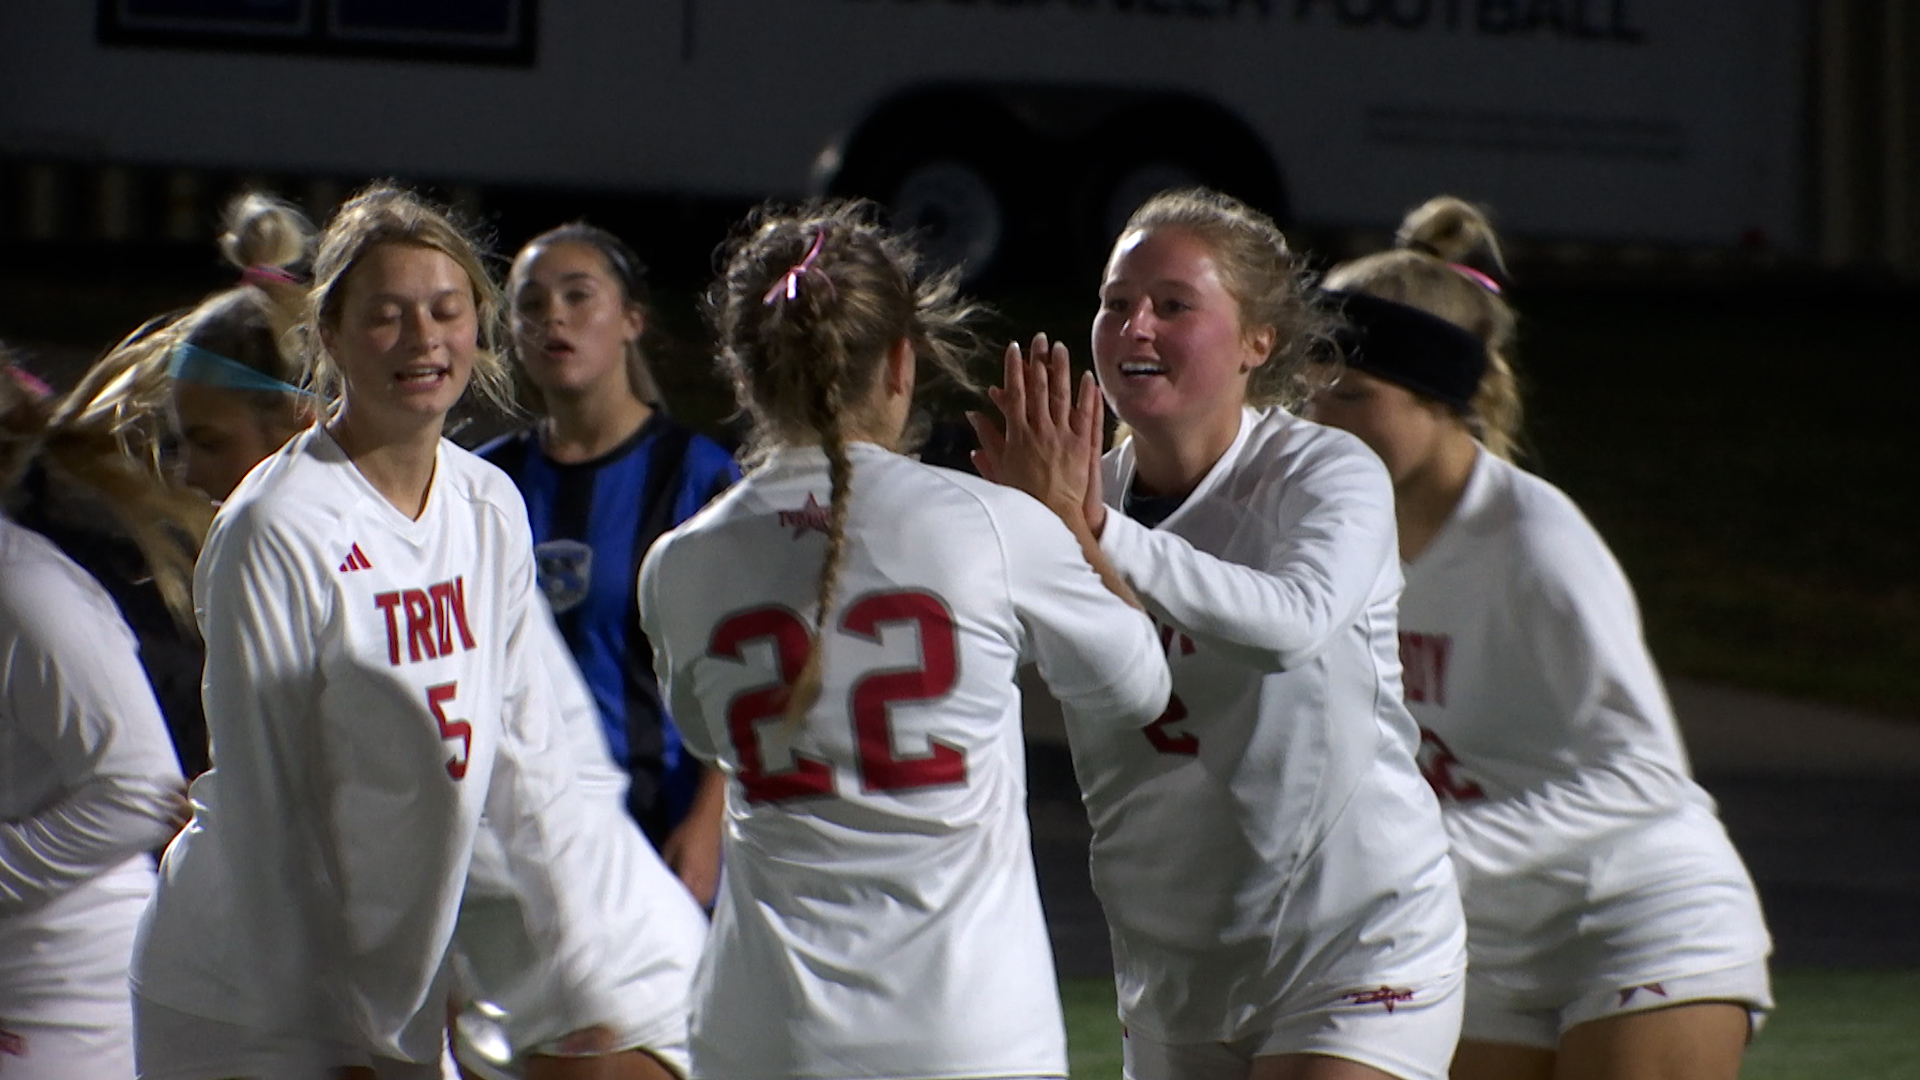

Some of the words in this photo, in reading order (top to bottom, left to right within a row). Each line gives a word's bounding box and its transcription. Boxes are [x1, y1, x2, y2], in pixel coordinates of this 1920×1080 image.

[1294, 0, 1642, 44] TBALL
[373, 574, 477, 667] TROY
[426, 681, 472, 782] 5
[705, 586, 970, 803] 22
